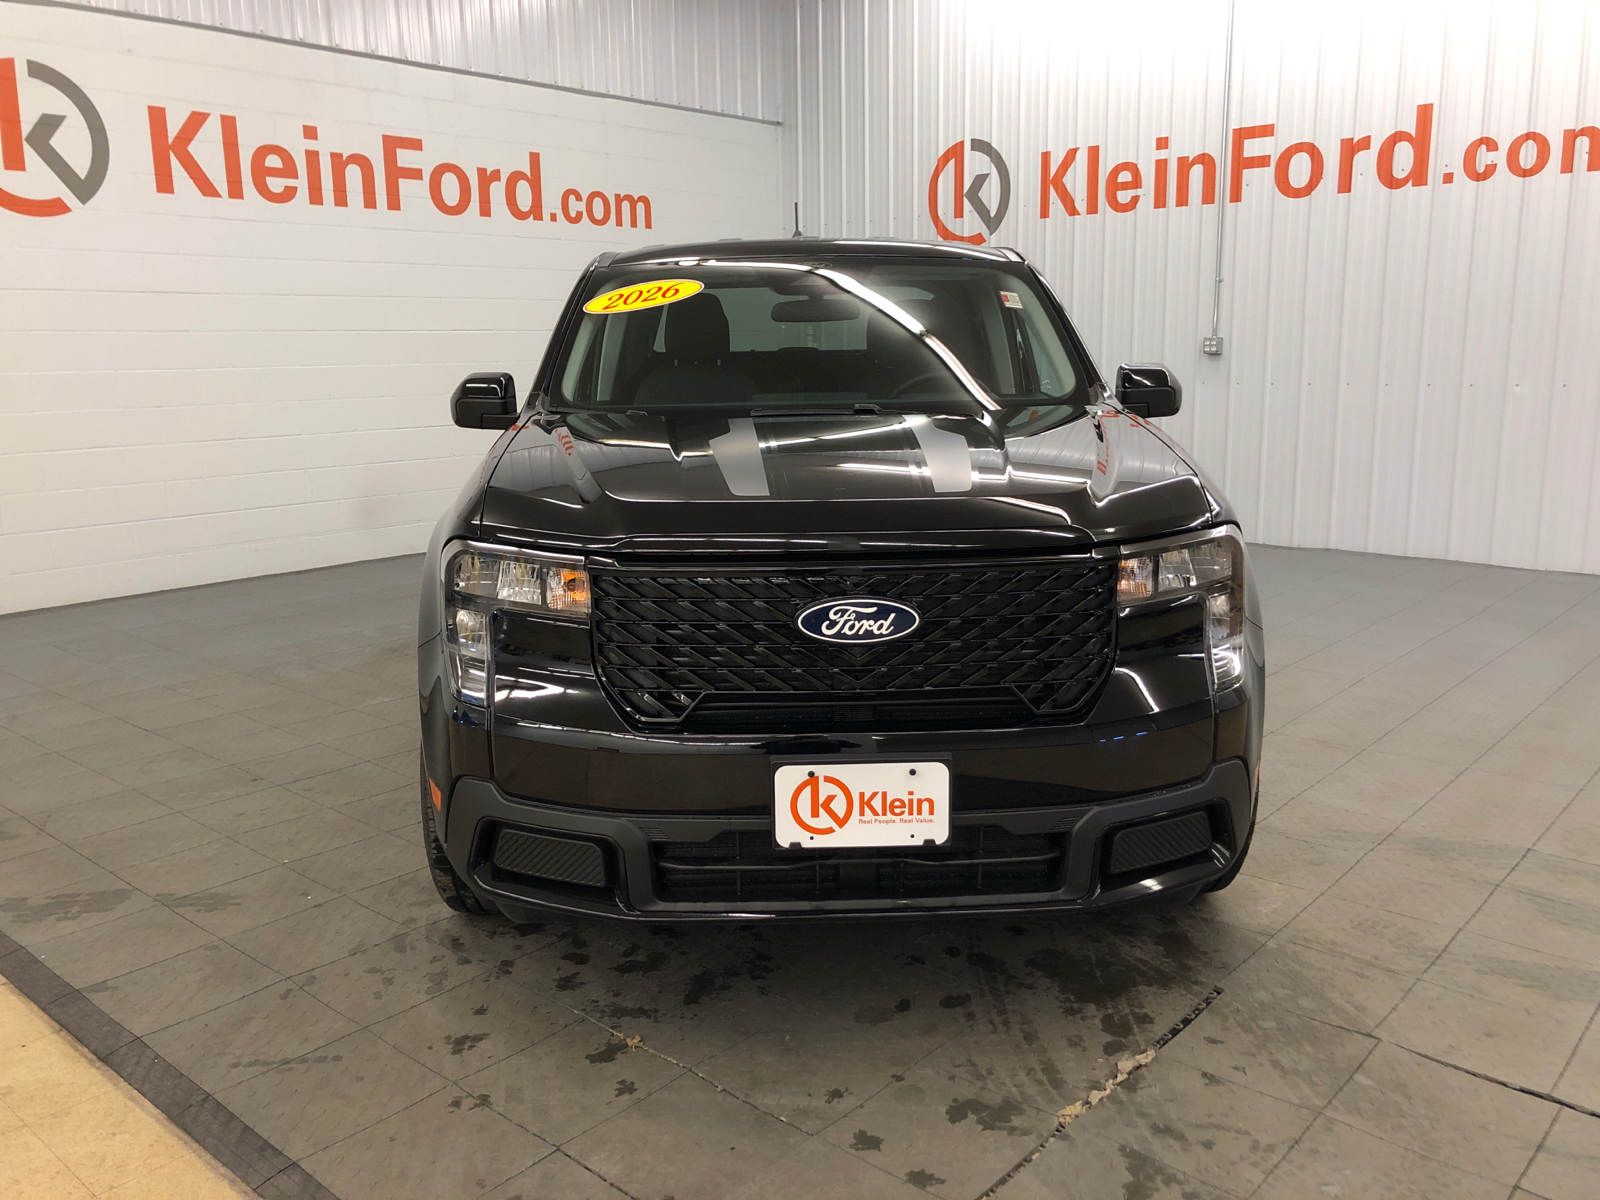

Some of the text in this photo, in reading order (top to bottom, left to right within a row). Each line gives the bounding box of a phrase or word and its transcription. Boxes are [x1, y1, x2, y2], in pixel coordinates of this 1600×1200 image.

[147, 105, 653, 230] KleinFord.com
[602, 282, 684, 310] 2026
[821, 605, 896, 635] Ford
[858, 790, 935, 817] Klein
[874, 818, 898, 826] People.
